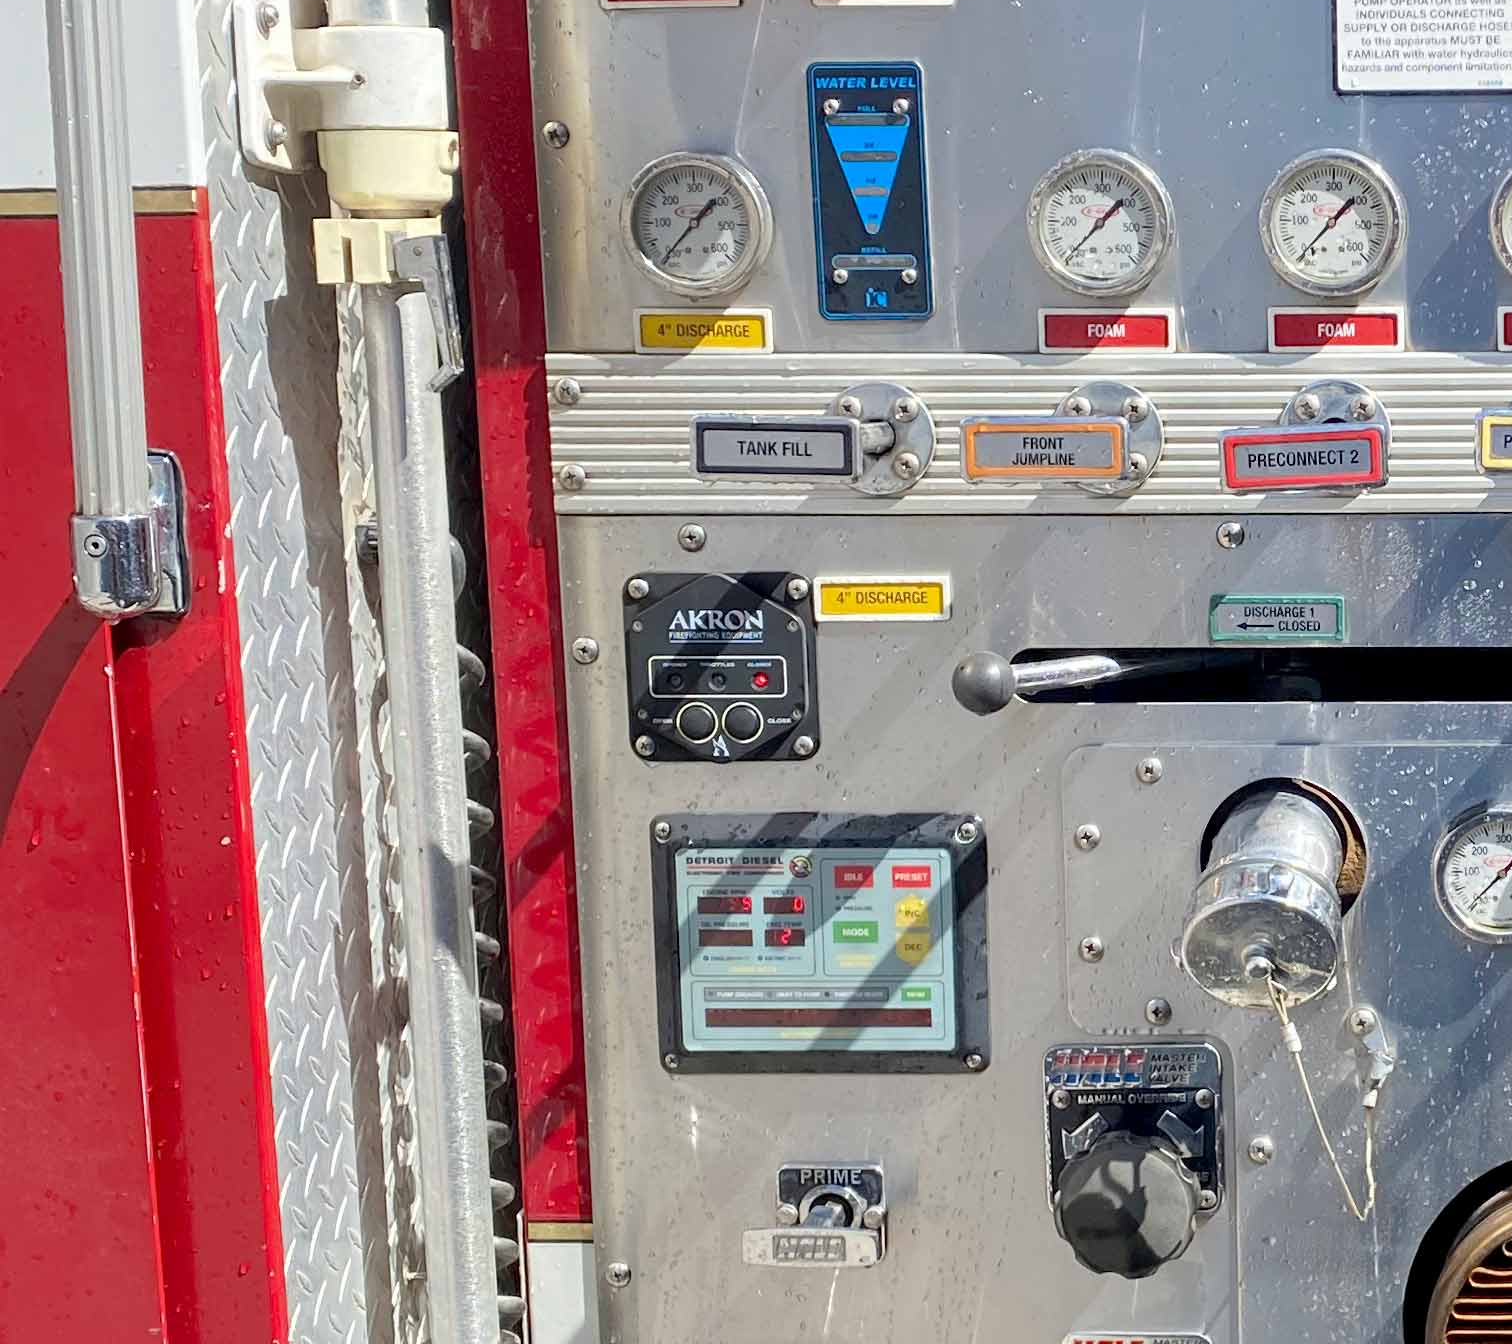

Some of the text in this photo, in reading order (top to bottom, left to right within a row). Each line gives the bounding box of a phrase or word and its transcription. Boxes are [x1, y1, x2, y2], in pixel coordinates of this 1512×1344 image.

[815, 77, 916, 89] WATER LEVEL
[1300, 192, 1318, 204] 200
[657, 324, 750, 338] 4" DISCHARGE
[1087, 323, 1126, 337] FOAM
[1317, 322, 1356, 337] FOAM
[736, 440, 813, 457] TANK FILL
[1022, 437, 1064, 450] FRONT
[1012, 452, 1075, 466] JUMPLINE
[1247, 449, 1359, 469] PRECONNECT 2
[836, 591, 928, 604] 4" DISCHARGE
[1244, 606, 1315, 618] DISCHARGE 1
[669, 609, 764, 631] AKRON
[1278, 620, 1321, 632] CLOSED
[686, 856, 784, 865] DETROIT DIESEL
[893, 871, 928, 882] PRESET
[842, 927, 870, 937] MODE
[800, 1169, 863, 1185] PRIME
